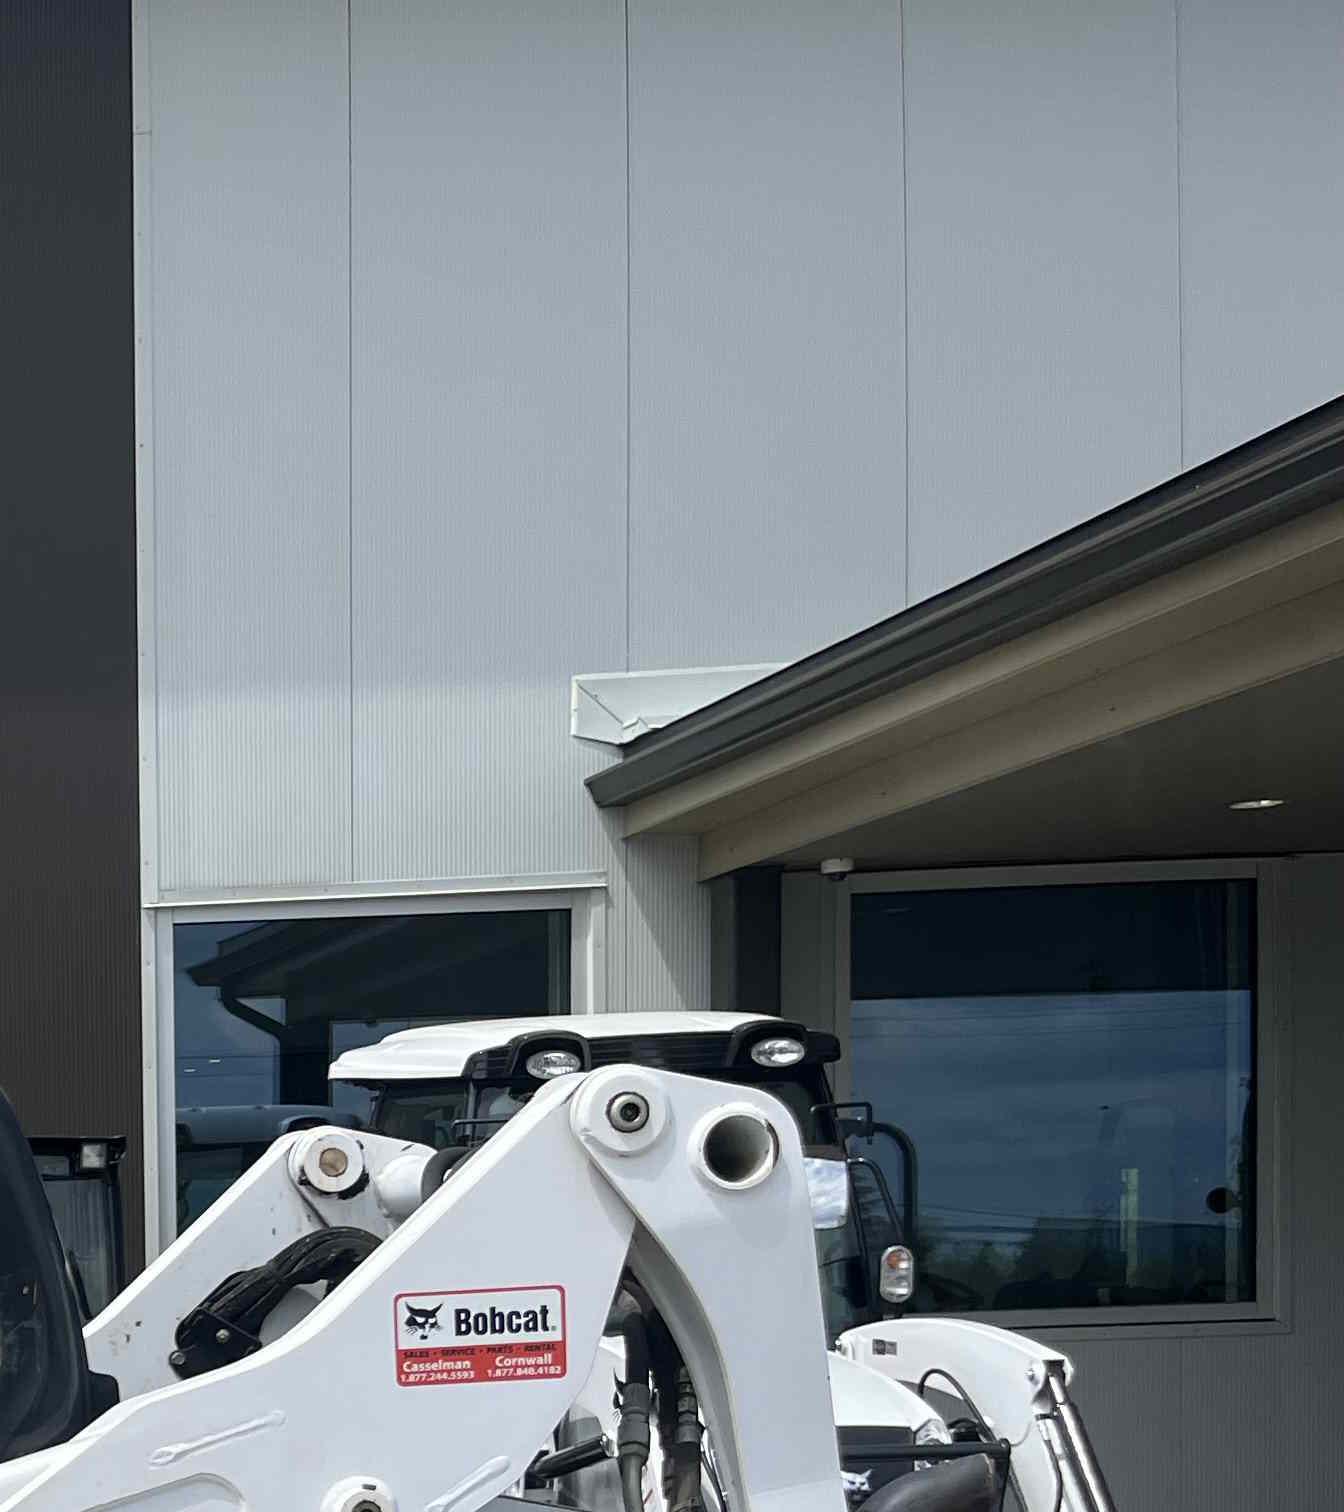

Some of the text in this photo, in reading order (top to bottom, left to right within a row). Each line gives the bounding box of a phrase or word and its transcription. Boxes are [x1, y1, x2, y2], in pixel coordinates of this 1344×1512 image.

[455, 1305, 549, 1336] Bobcat
[442, 1347, 476, 1357] SERVICE
[487, 1344, 512, 1354] PARTS
[524, 1342, 556, 1353] RENTAL
[403, 1359, 472, 1373] Casselman
[495, 1354, 552, 1367] Cornwall
